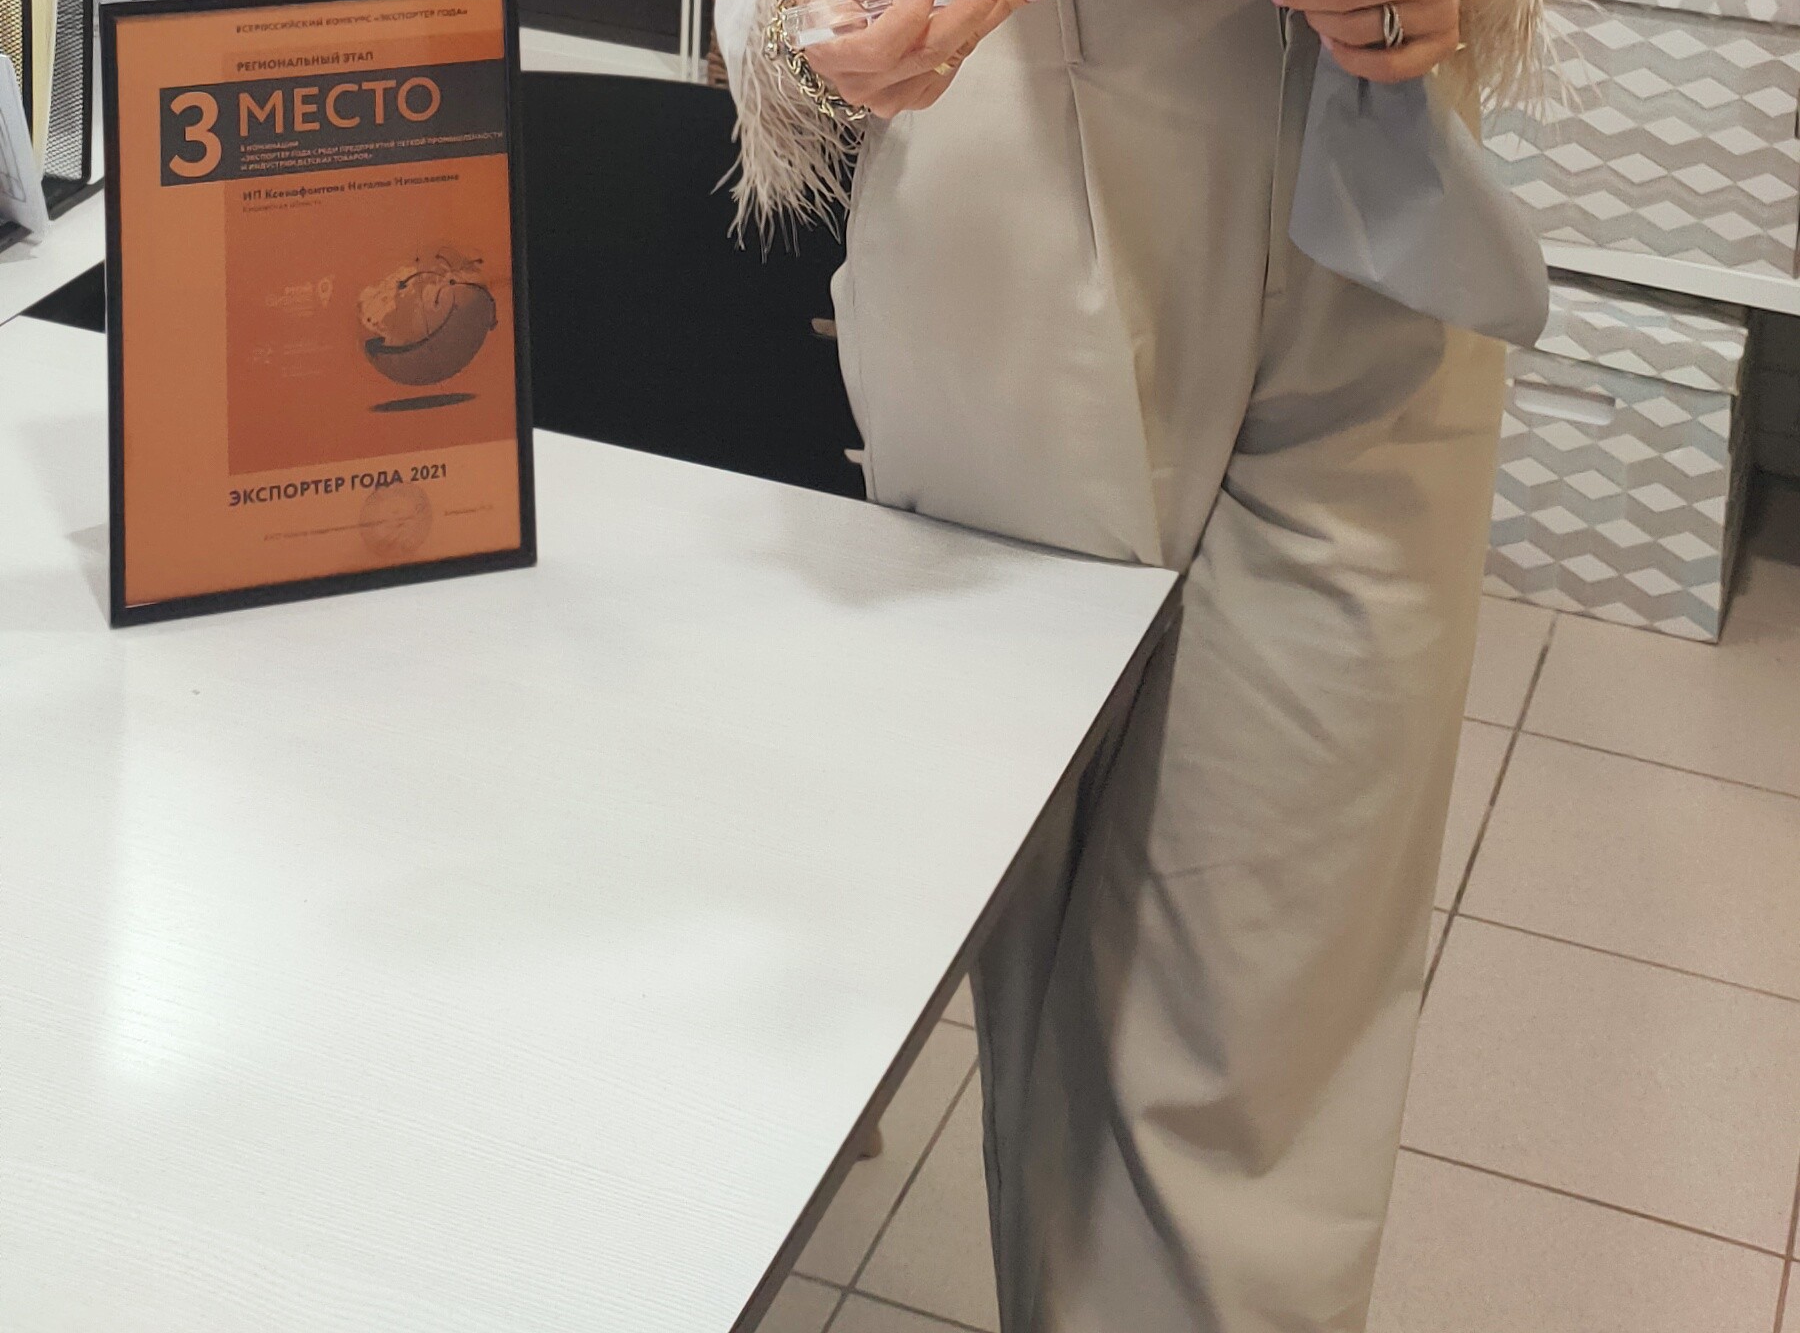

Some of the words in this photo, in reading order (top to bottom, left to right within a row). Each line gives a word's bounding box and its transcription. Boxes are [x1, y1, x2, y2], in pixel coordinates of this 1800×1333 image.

[236, 52, 340, 72] РЕГИОНАЛЬНЫЙ
[343, 51, 374, 64] ЭТАП
[168, 90, 222, 178] 3
[239, 77, 442, 137] МЕСТО
[243, 189, 262, 201] ИП
[229, 476, 345, 507] ЭКСПОРТЕР
[351, 469, 403, 491] ГОДА
[410, 463, 447, 482] 2021
